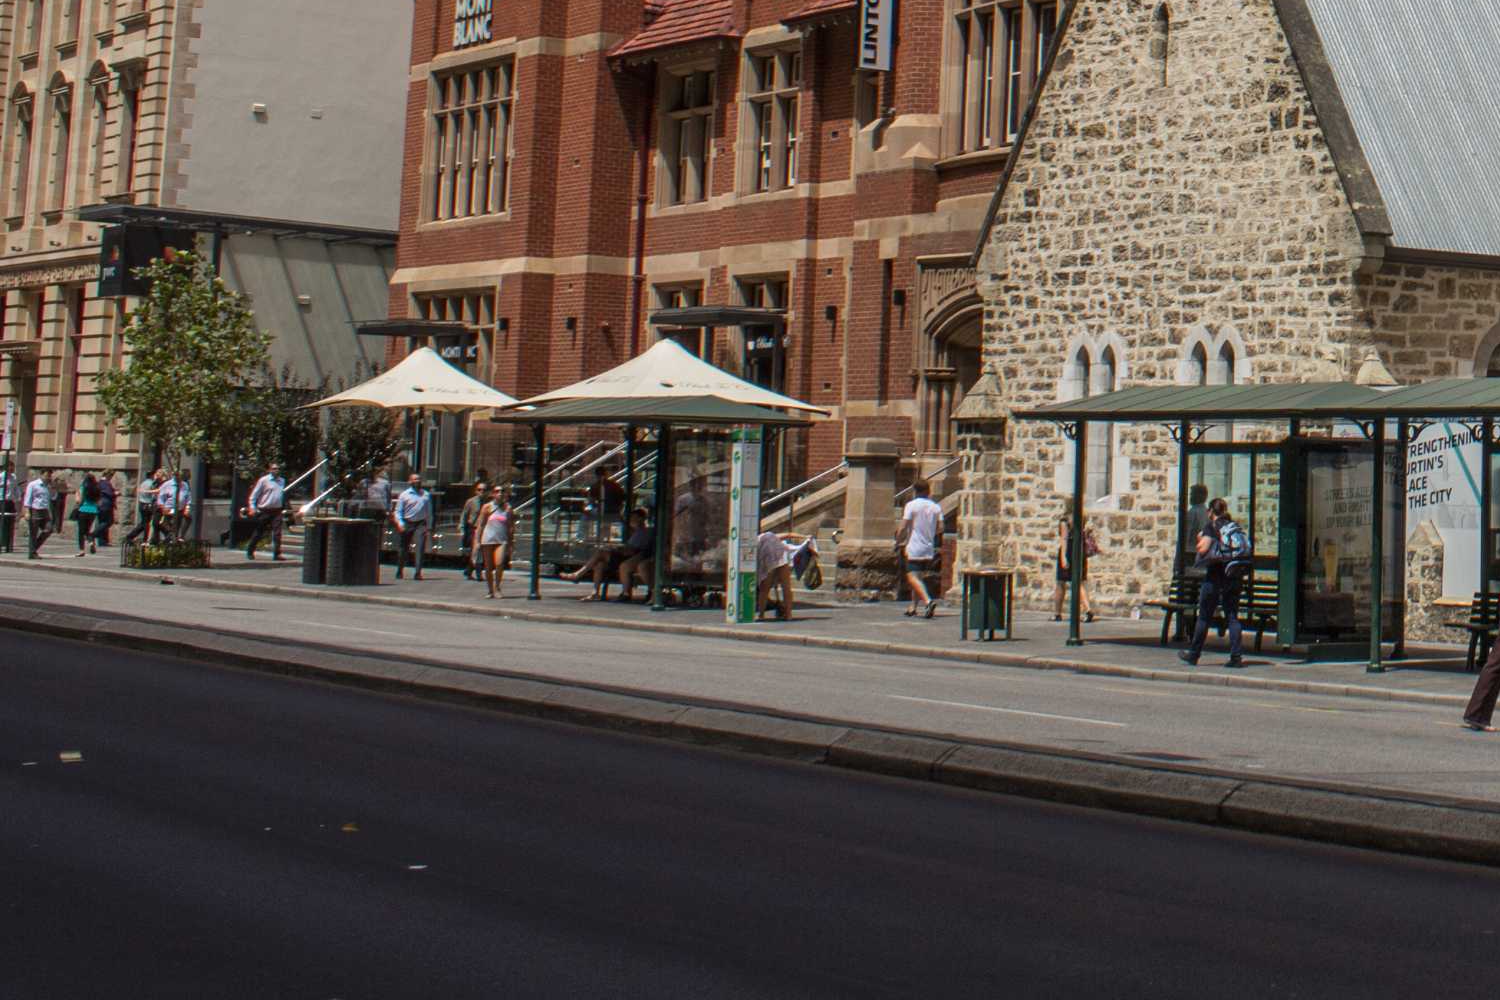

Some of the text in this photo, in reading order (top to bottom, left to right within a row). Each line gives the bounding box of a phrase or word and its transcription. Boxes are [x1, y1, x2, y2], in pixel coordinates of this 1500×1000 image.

[453, 13, 493, 47] BLANC
[1408, 487, 1453, 510] THE CITY
